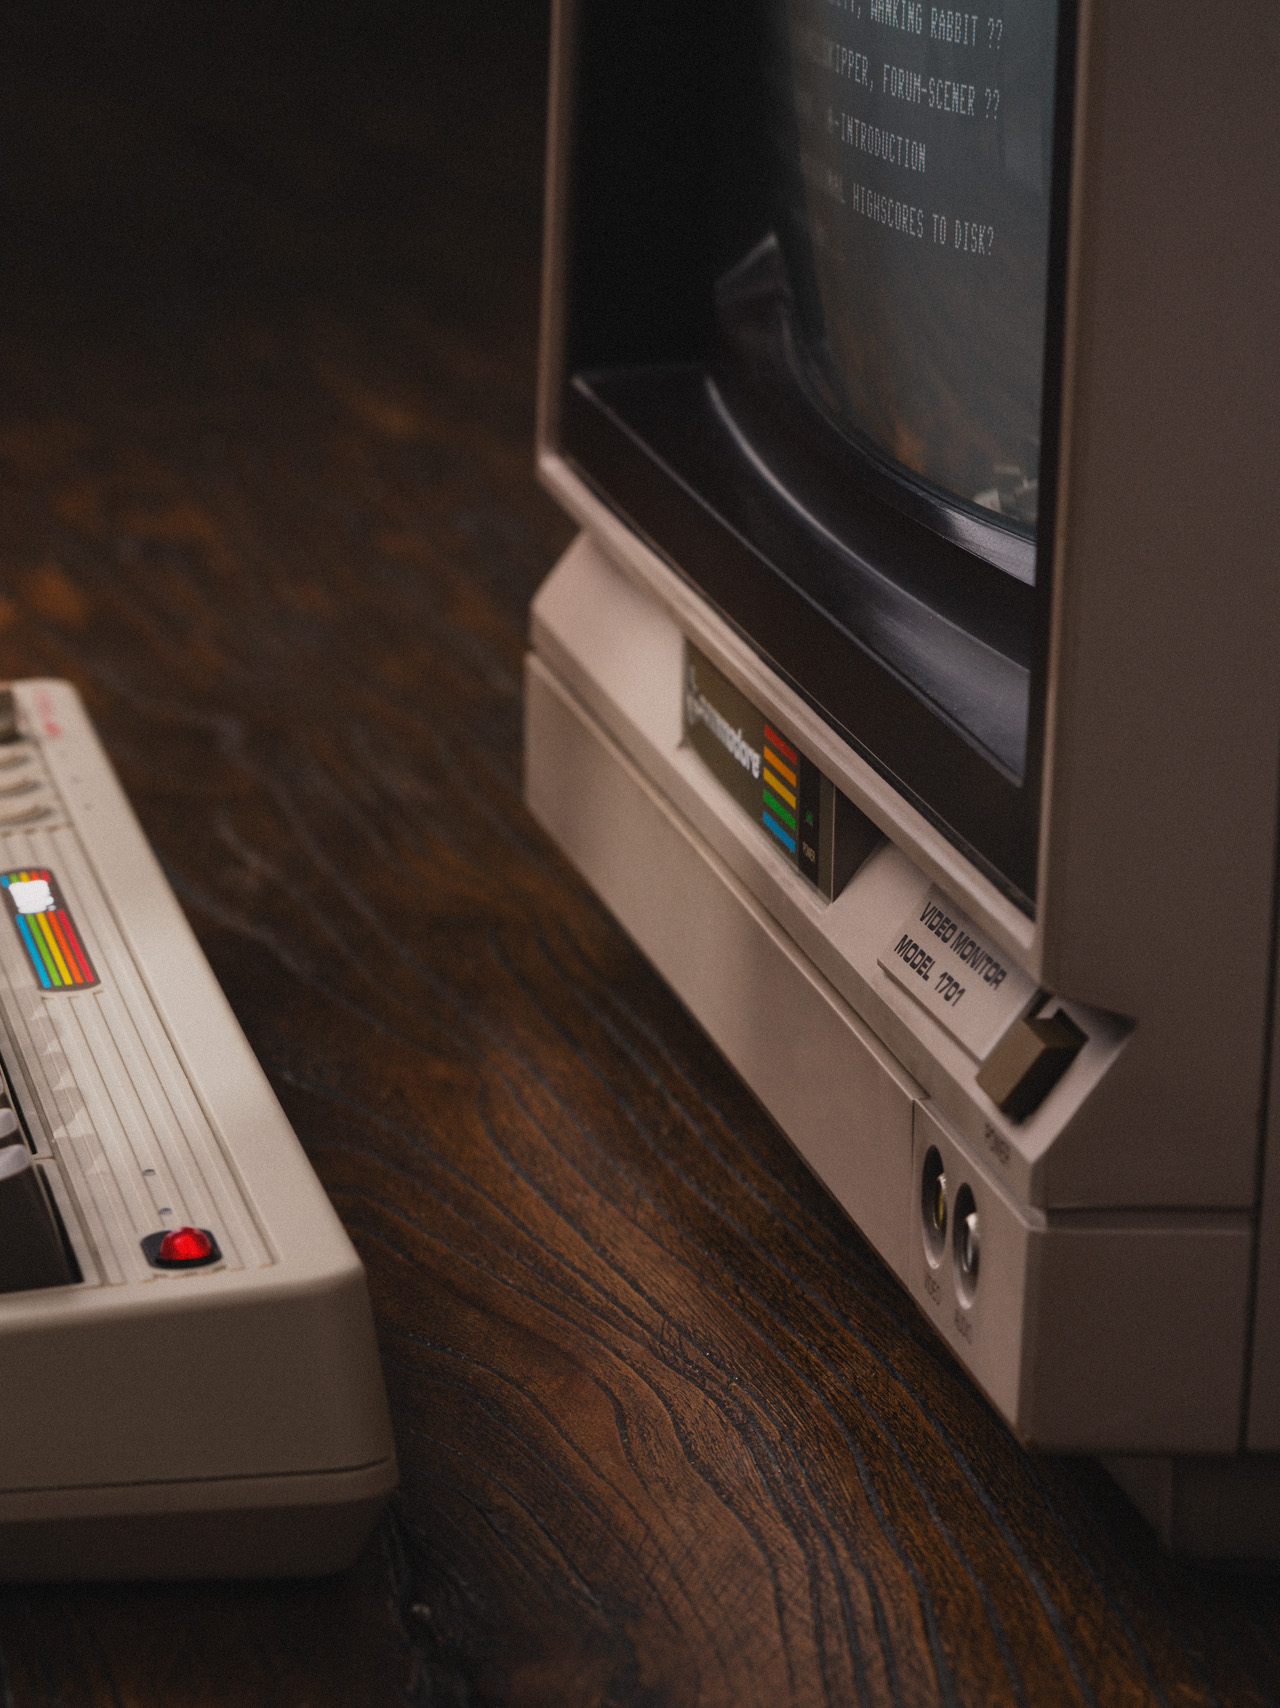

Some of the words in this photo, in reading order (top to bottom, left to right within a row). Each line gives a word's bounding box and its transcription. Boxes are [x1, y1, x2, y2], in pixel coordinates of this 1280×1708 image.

[930, 7, 978, 46] RABBIT
[987, 17, 1003, 49] ??
[823, 38, 874, 92] IPPER,
[883, 64, 975, 116] FORUM-SCENER
[984, 88, 1000, 119] ??
[852, 182, 924, 238] HIGHSCORES
[932, 213, 947, 245] TO
[954, 219, 994, 255] DISK?
[893, 934, 936, 982] MODEL
[934, 972, 966, 1007] 1701
[919, 901, 958, 944] VIDEO
[949, 931, 1007, 991] MONITOR
